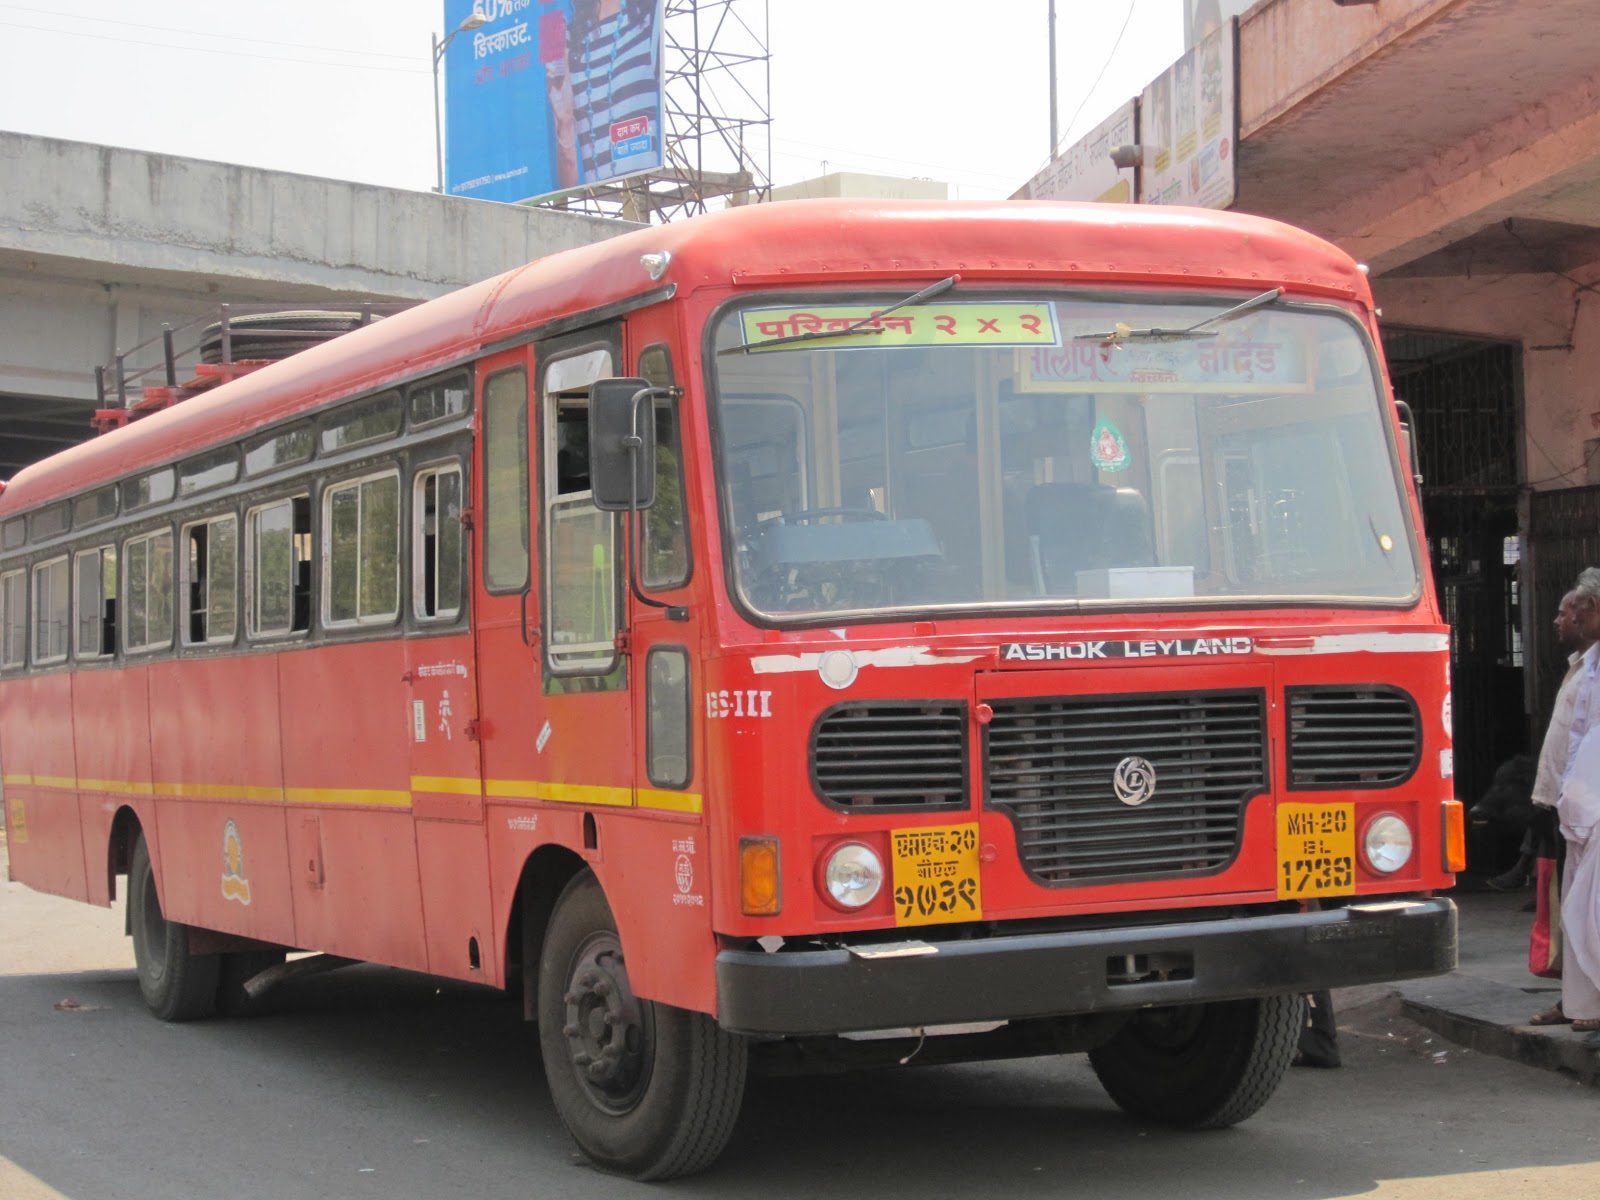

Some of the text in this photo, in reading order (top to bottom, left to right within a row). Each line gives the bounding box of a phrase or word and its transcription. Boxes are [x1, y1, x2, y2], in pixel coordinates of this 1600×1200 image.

[616, 122, 641, 138] दाम कम
[756, 310, 915, 341] परिवर्तन
[932, 314, 957, 336] २
[1018, 313, 1042, 335] २
[1005, 637, 1253, 661] ASHOK LEYLAND
[1287, 810, 1347, 836] MH-20
[1303, 840, 1331, 855] BL
[1282, 856, 1352, 892] 1739
